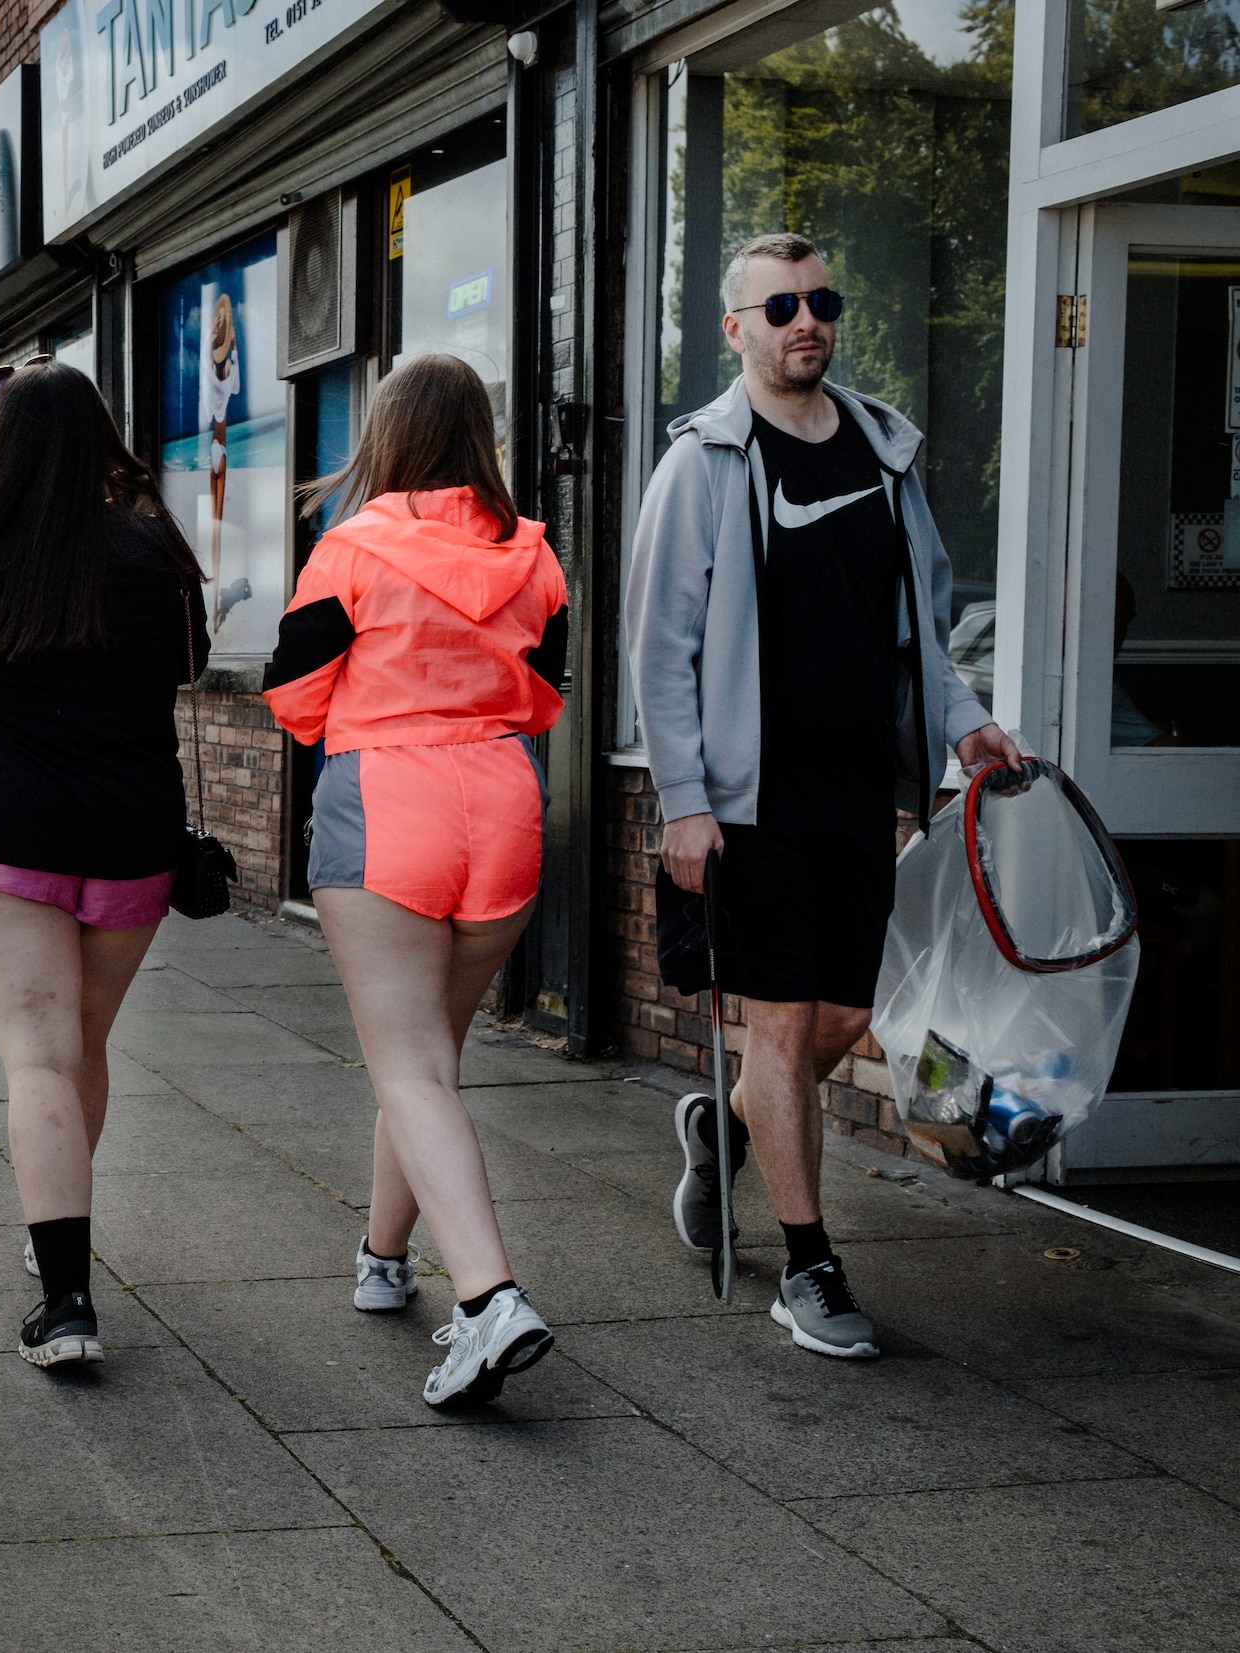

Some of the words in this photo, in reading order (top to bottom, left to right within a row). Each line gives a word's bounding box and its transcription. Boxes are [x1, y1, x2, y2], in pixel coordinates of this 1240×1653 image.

[96, 0, 259, 126] TANTA
[264, 17, 283, 44] TEL.
[286, 0, 307, 28] 0151
[102, 144, 118, 170] HIGH
[118, 123, 146, 159] POWERED
[147, 99, 175, 136] SUNBEDS
[183, 59, 227, 109] SUNSHOWER
